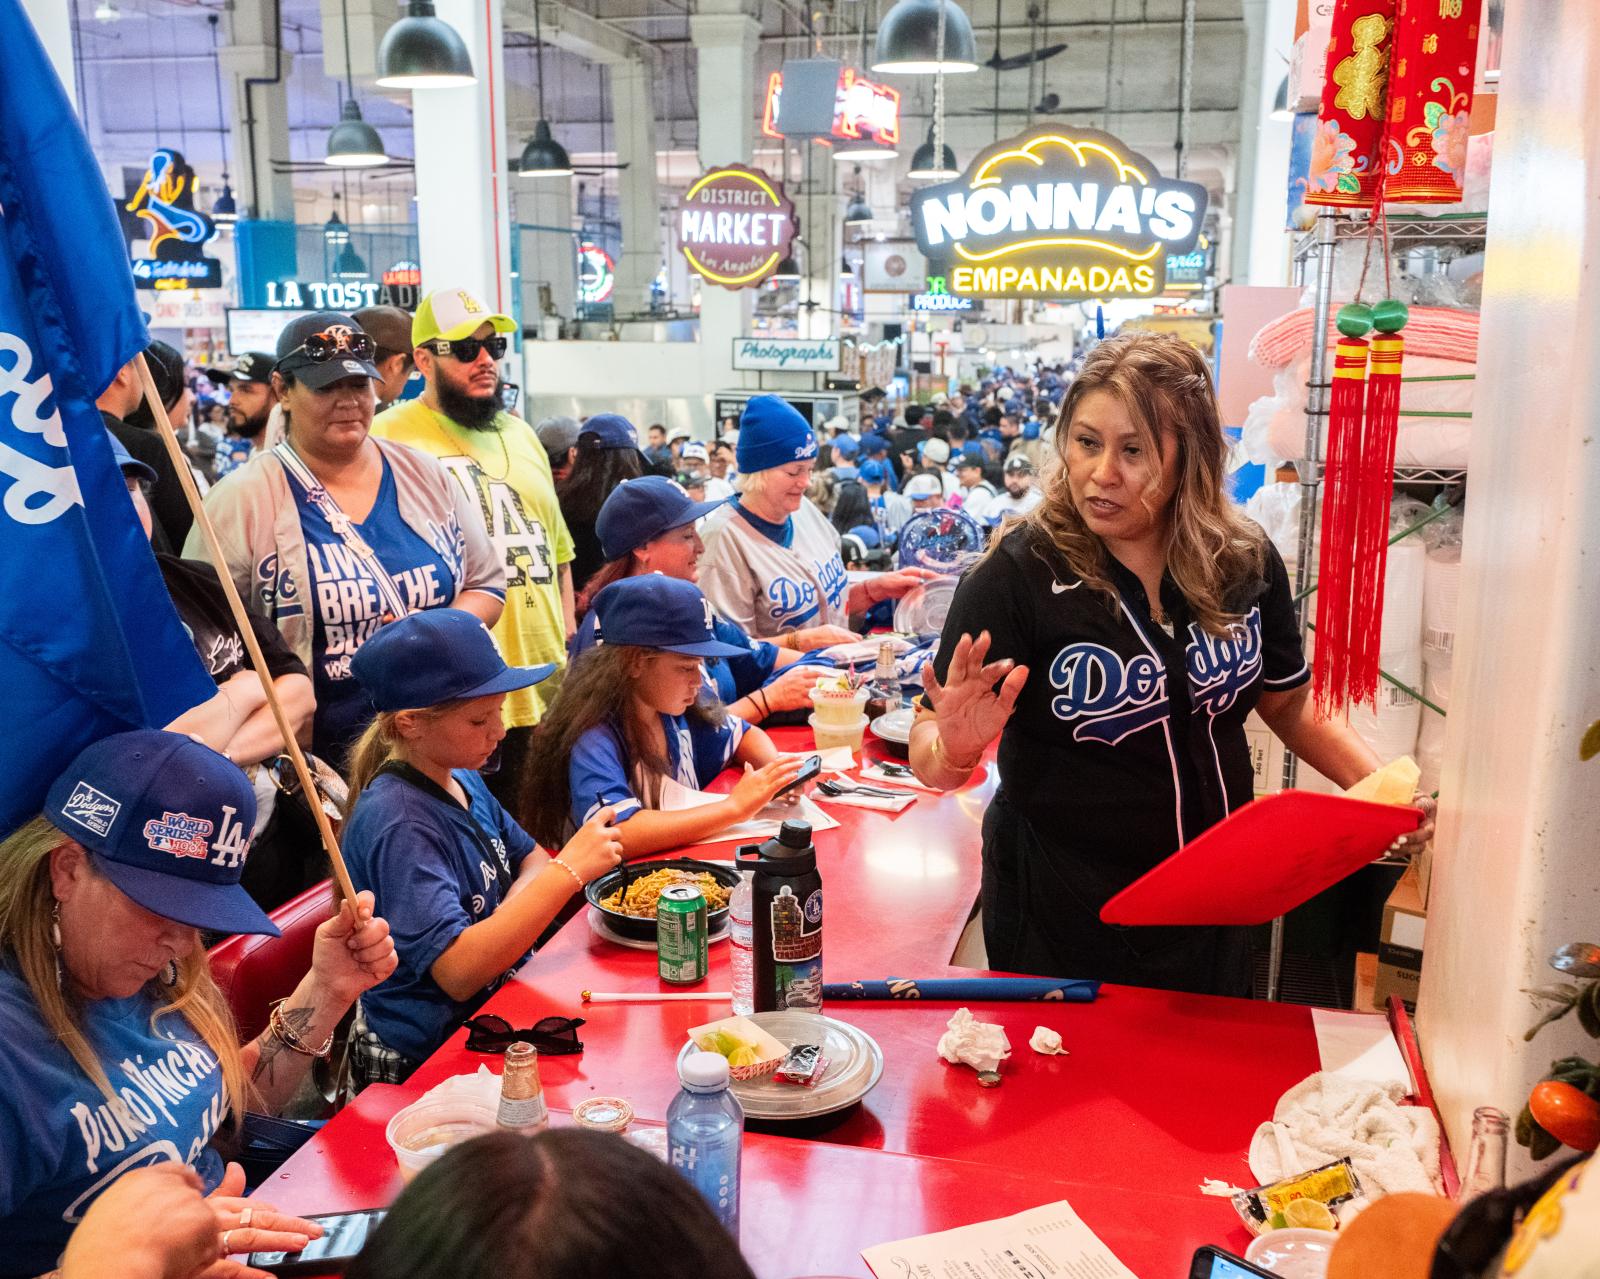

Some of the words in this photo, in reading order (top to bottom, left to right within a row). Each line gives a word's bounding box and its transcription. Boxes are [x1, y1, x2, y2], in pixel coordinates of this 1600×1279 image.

[701, 188, 768, 206] DISTRICT
[681, 210, 786, 246] MARKET
[921, 182, 1197, 246] NONNA'S
[952, 265, 1155, 294] EMPANADAS
[266, 281, 303, 308] LA
[740, 339, 834, 367] Photographs
[316, 564, 447, 625] BRETHE.
[149, 823, 195, 840] SERIES
[167, 816, 209, 833] WORLD
[211, 805, 246, 868] LA
